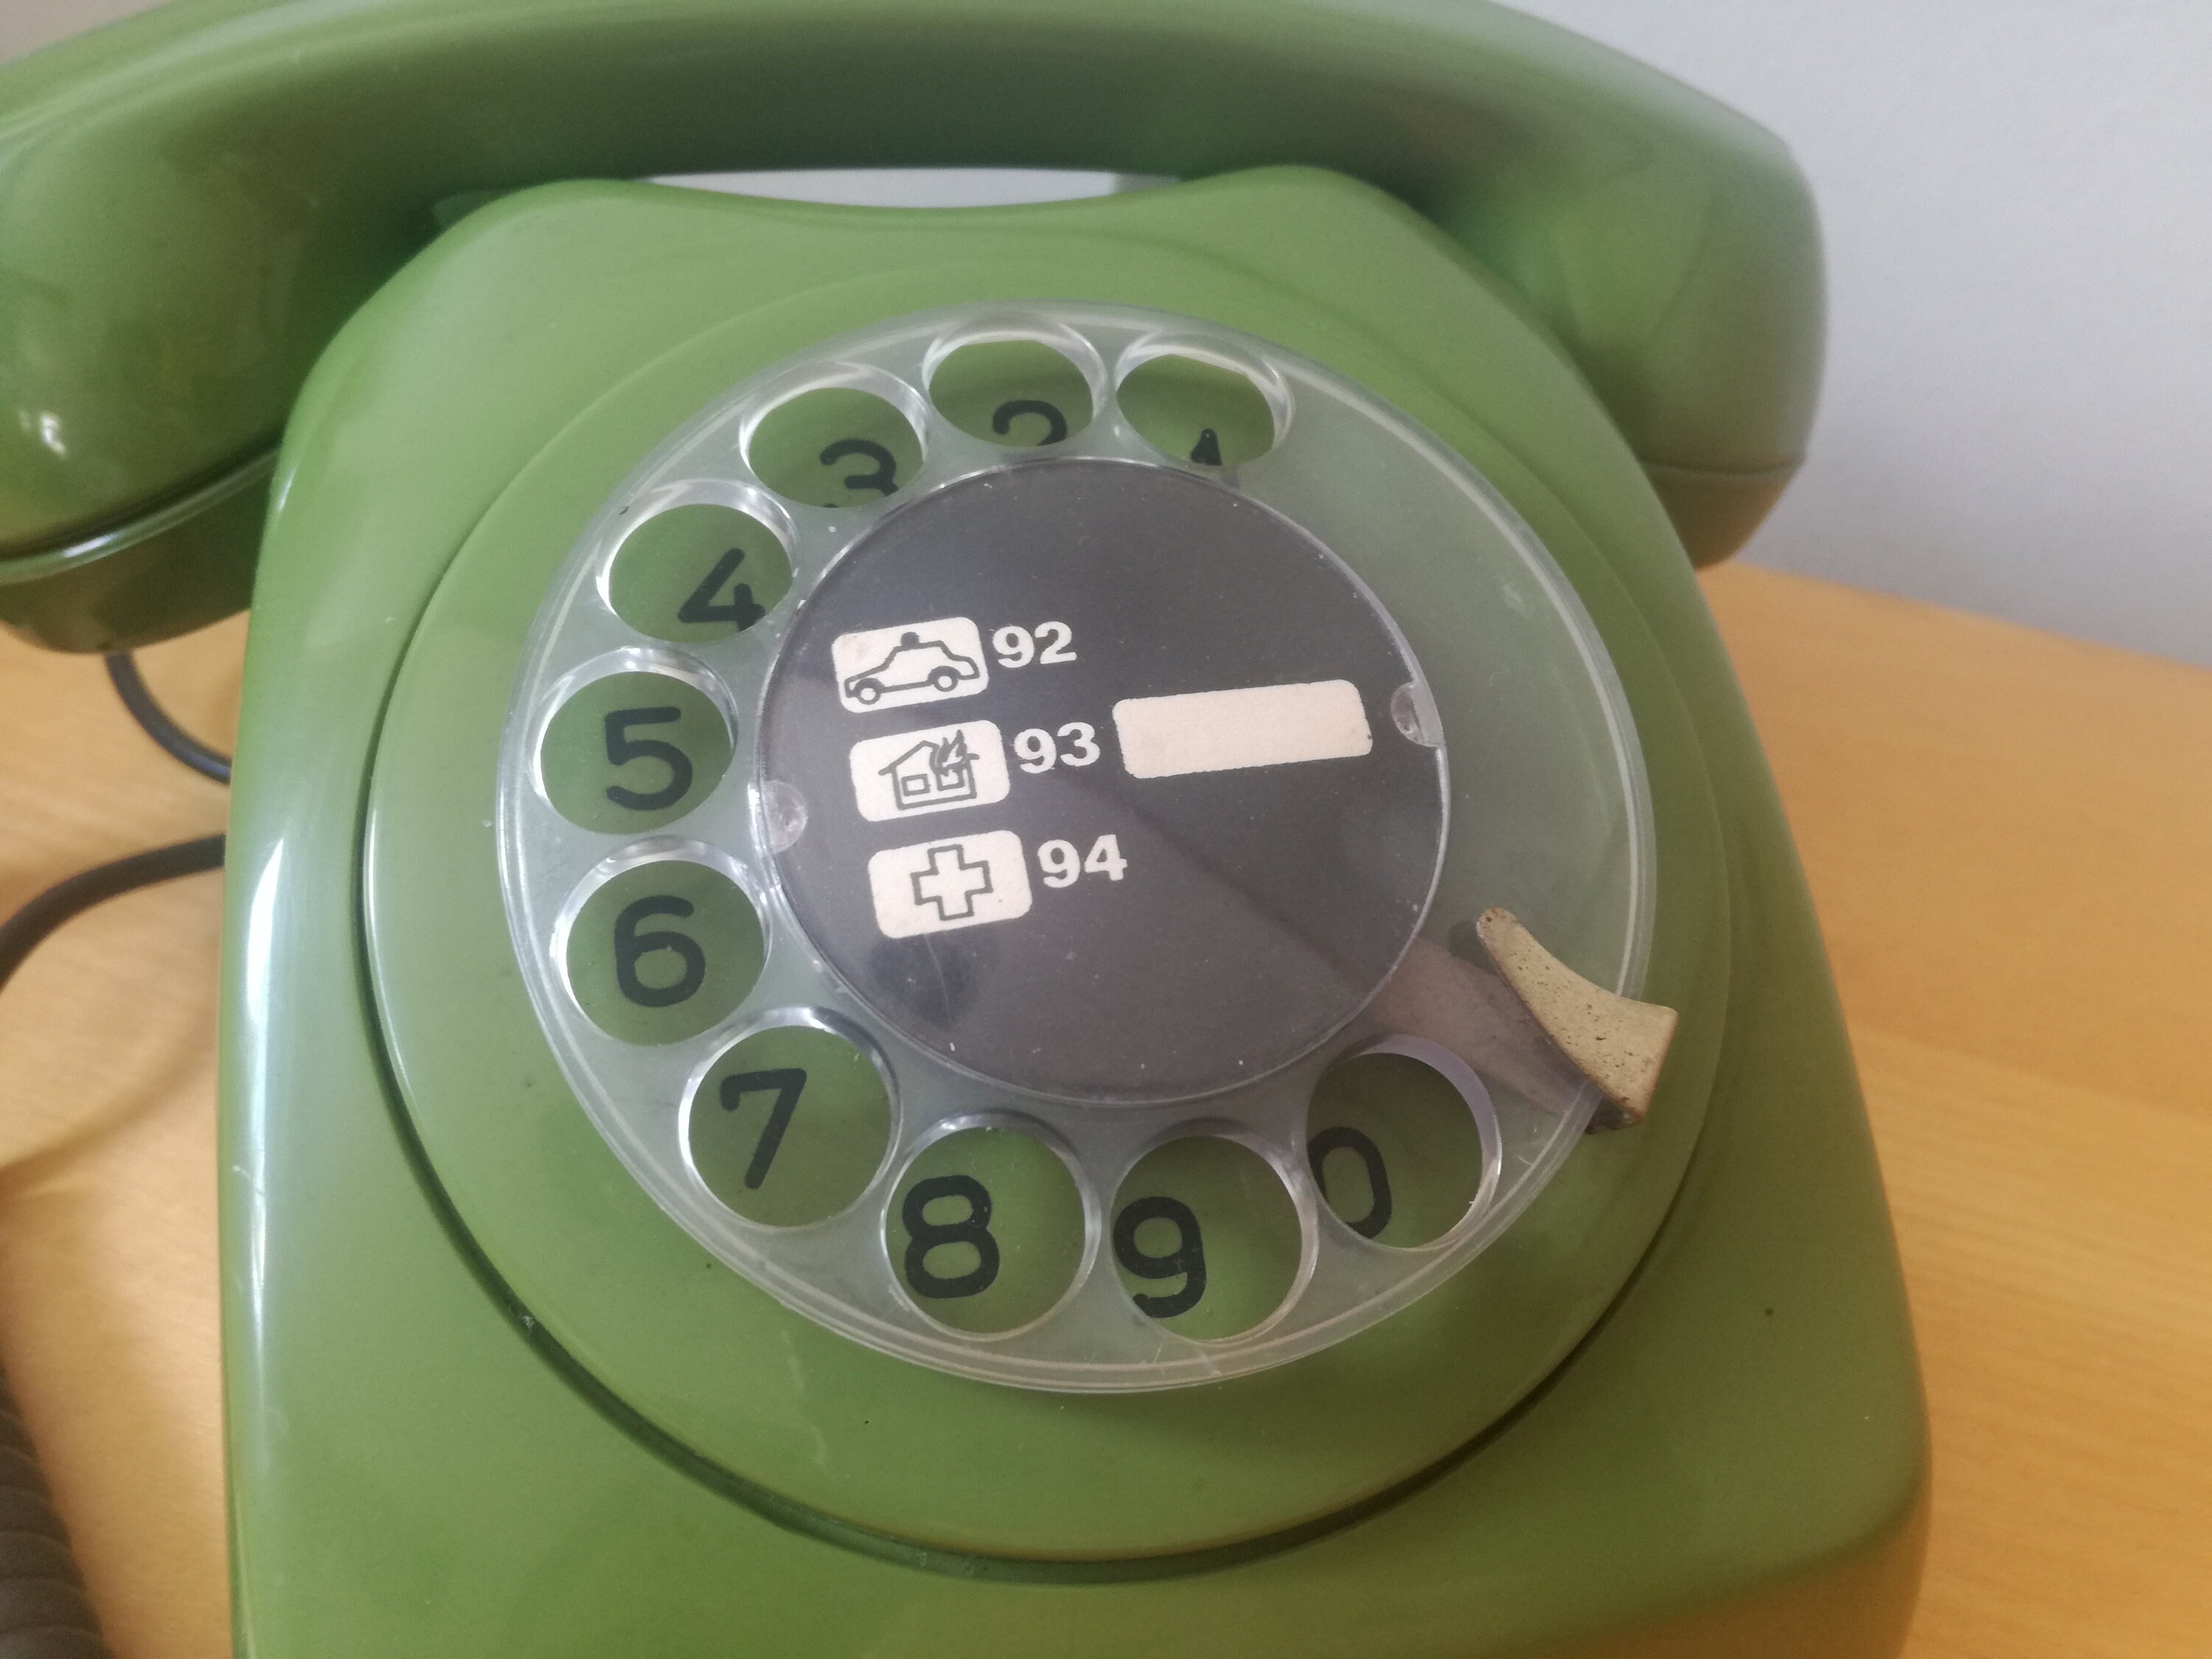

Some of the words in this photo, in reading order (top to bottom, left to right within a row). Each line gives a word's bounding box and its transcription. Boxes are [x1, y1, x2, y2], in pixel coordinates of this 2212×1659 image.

[677, 548, 766, 633] 4
[992, 621, 1077, 669] 92
[604, 706, 693, 811] 5
[1012, 721, 1101, 774] 93
[1037, 834, 1128, 888] 94
[613, 894, 706, 1008] 6
[719, 1068, 808, 1189] 7
[1307, 1126, 1393, 1240] 0
[902, 1175, 1001, 1299] 8
[1111, 1196, 1207, 1319] 9
